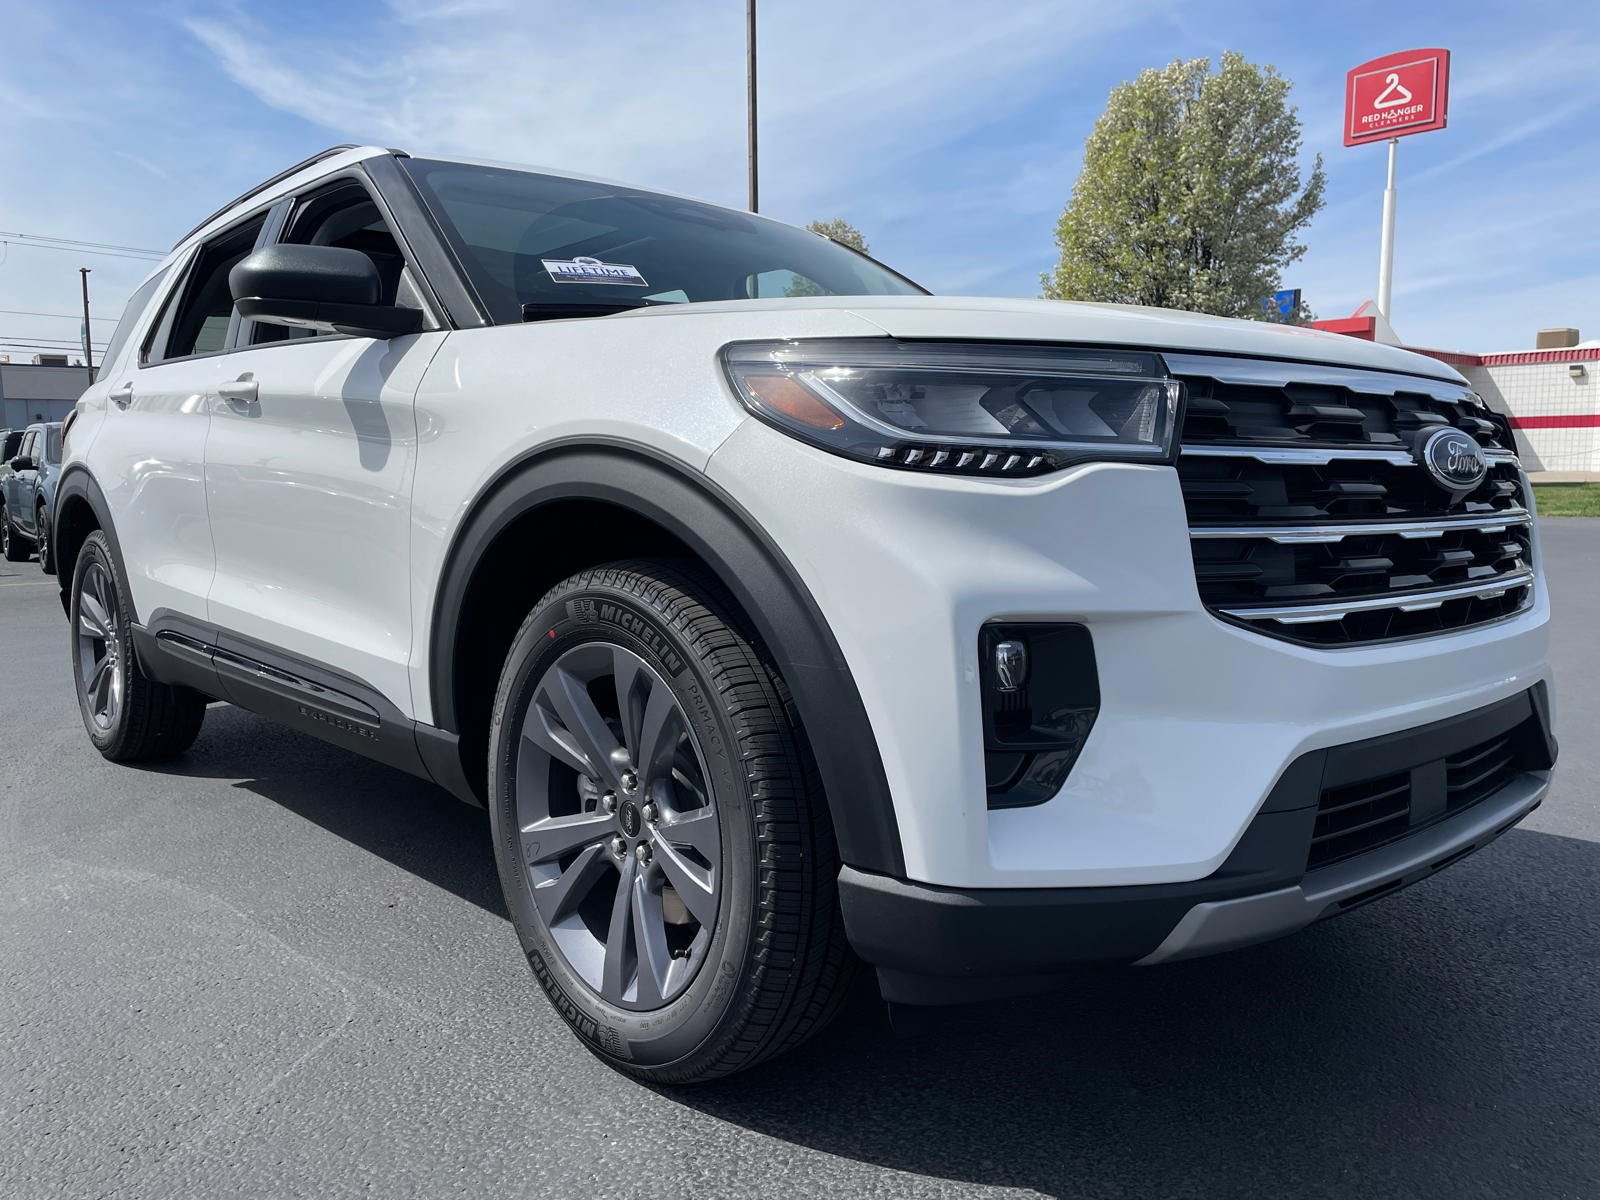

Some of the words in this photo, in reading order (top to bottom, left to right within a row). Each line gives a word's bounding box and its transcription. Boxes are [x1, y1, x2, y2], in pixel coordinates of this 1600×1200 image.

[1362, 114, 1380, 124] RED
[1369, 115, 1414, 128] CLEANERS
[557, 266, 630, 276] LIFETIME
[1447, 440, 1480, 473] Ford
[600, 604, 681, 672] MICHELIN
[688, 685, 725, 758] PRIMACY
[530, 954, 596, 1038] MICHELIN
